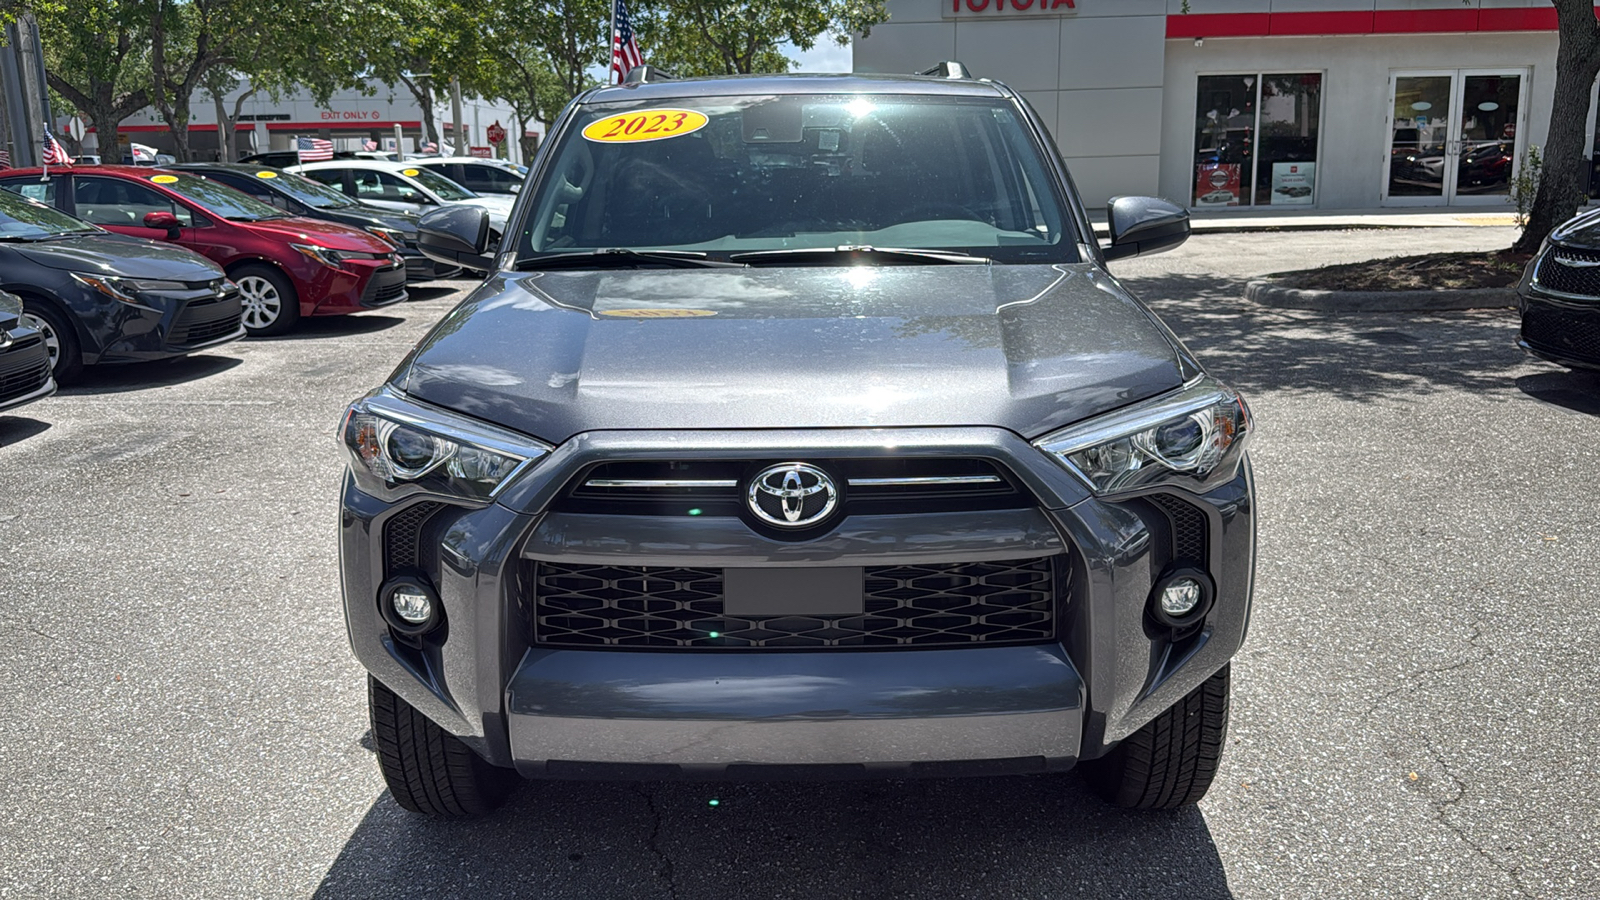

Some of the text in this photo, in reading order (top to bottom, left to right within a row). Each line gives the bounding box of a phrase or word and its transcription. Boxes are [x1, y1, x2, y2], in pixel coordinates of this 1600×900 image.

[321, 111, 368, 120] EXIT ONLY
[601, 113, 688, 138] 2023
